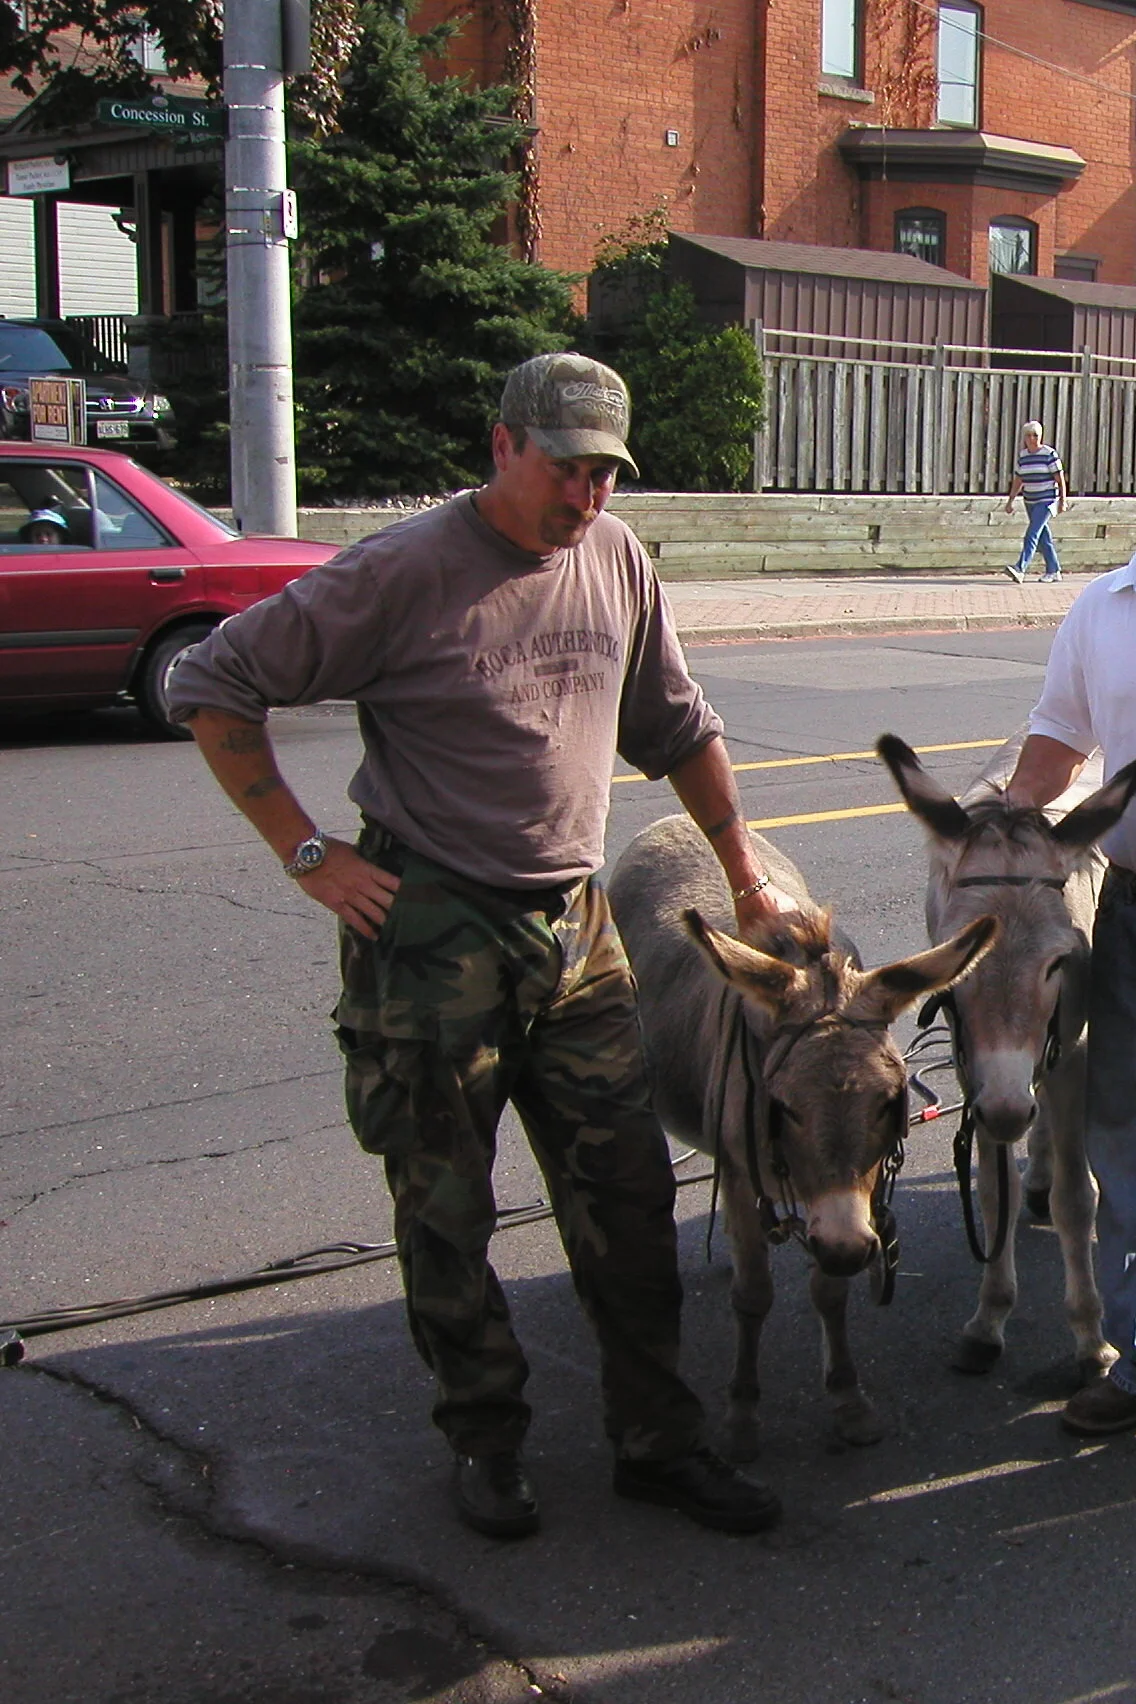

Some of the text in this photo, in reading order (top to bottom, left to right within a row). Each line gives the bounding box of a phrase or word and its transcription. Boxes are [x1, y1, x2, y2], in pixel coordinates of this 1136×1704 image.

[111, 103, 210, 127] Concession St.
[33, 403, 67, 424] FOR RENT
[532, 630, 619, 662] AUTHENTIC
[511, 671, 605, 704] AND COMPANY
